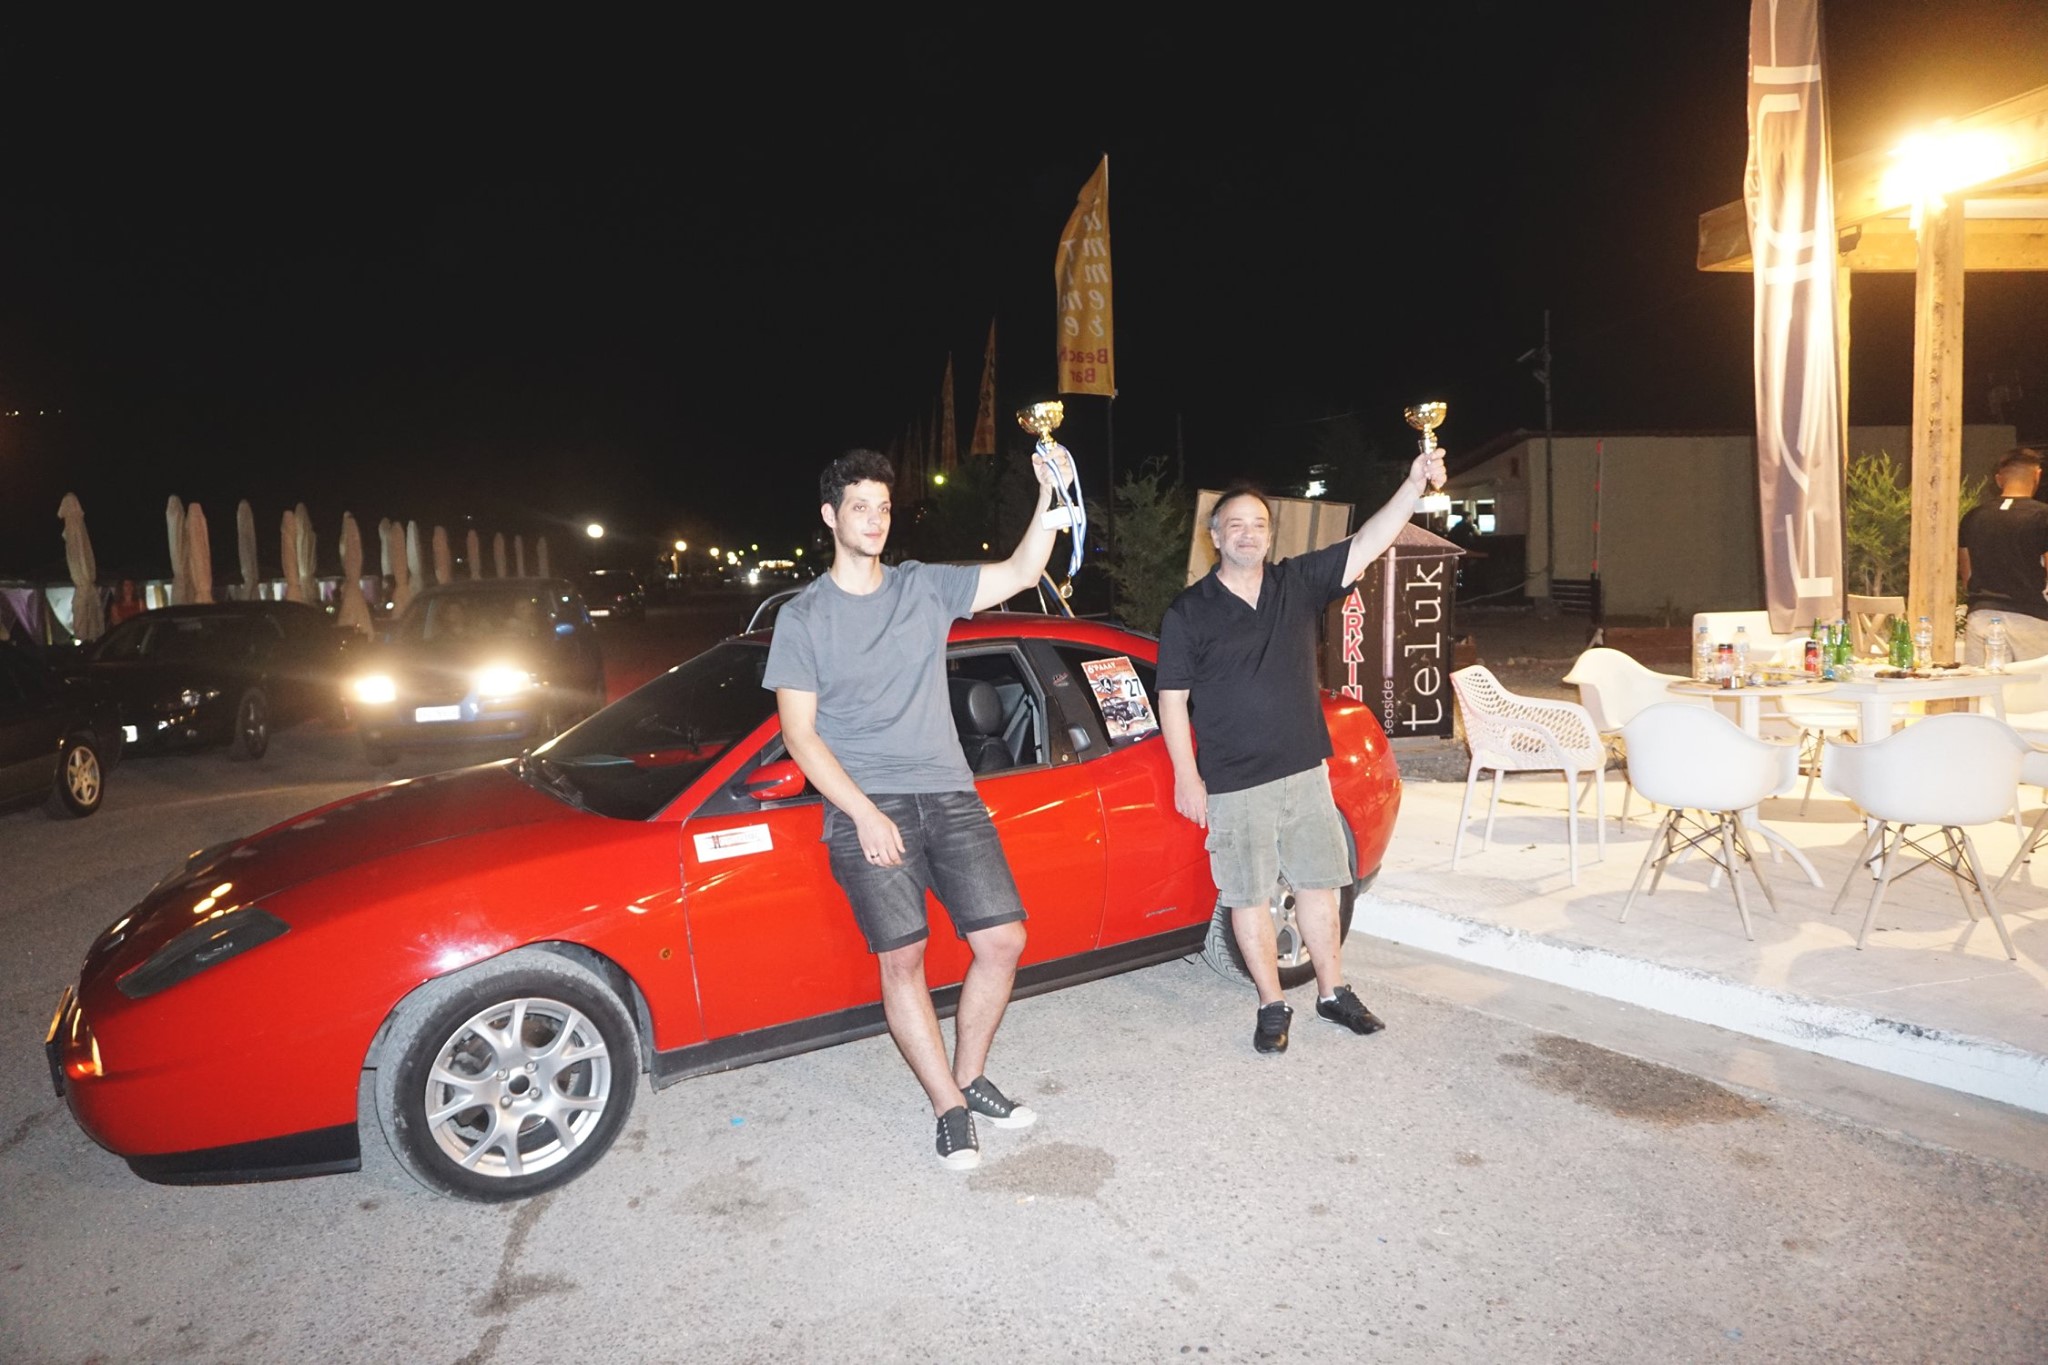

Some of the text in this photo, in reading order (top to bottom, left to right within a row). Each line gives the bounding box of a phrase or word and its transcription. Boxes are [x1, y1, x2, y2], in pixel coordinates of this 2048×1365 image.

[1342, 570, 1366, 702] ARKIN
[1402, 561, 1444, 731] teluk
[1125, 678, 1142, 697] 27
[1382, 680, 1394, 735] seaside
